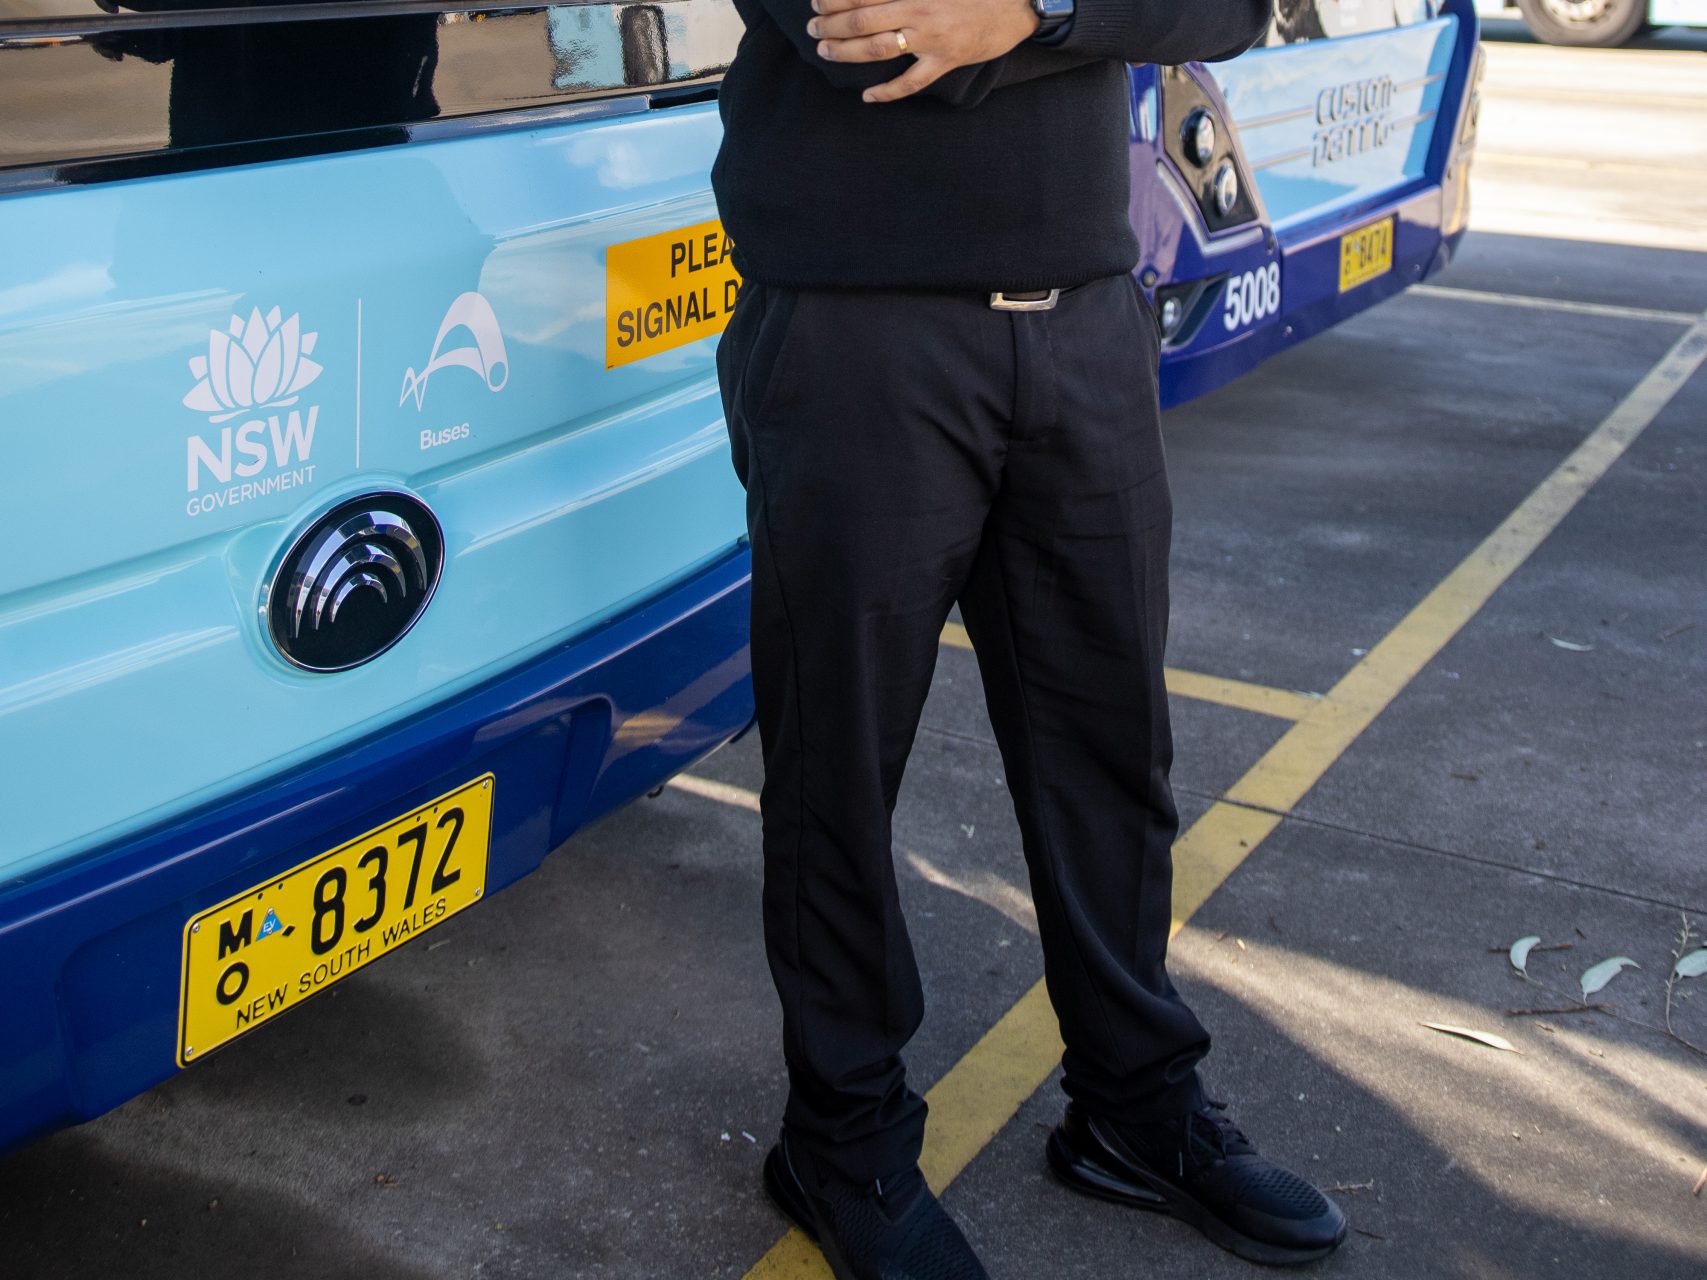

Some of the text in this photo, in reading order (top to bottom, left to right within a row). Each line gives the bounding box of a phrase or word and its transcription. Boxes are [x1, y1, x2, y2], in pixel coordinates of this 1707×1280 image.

[617, 287, 716, 348] SIGNAL
[1223, 261, 1280, 331] 5008
[187, 405, 320, 492] NSW
[419, 422, 471, 450] Buses
[186, 465, 316, 517] GOVERNMENT
[310, 806, 465, 955] 8372
[263, 918, 277, 933] EV
[235, 898, 447, 1030] NEW SOUTH WALES
